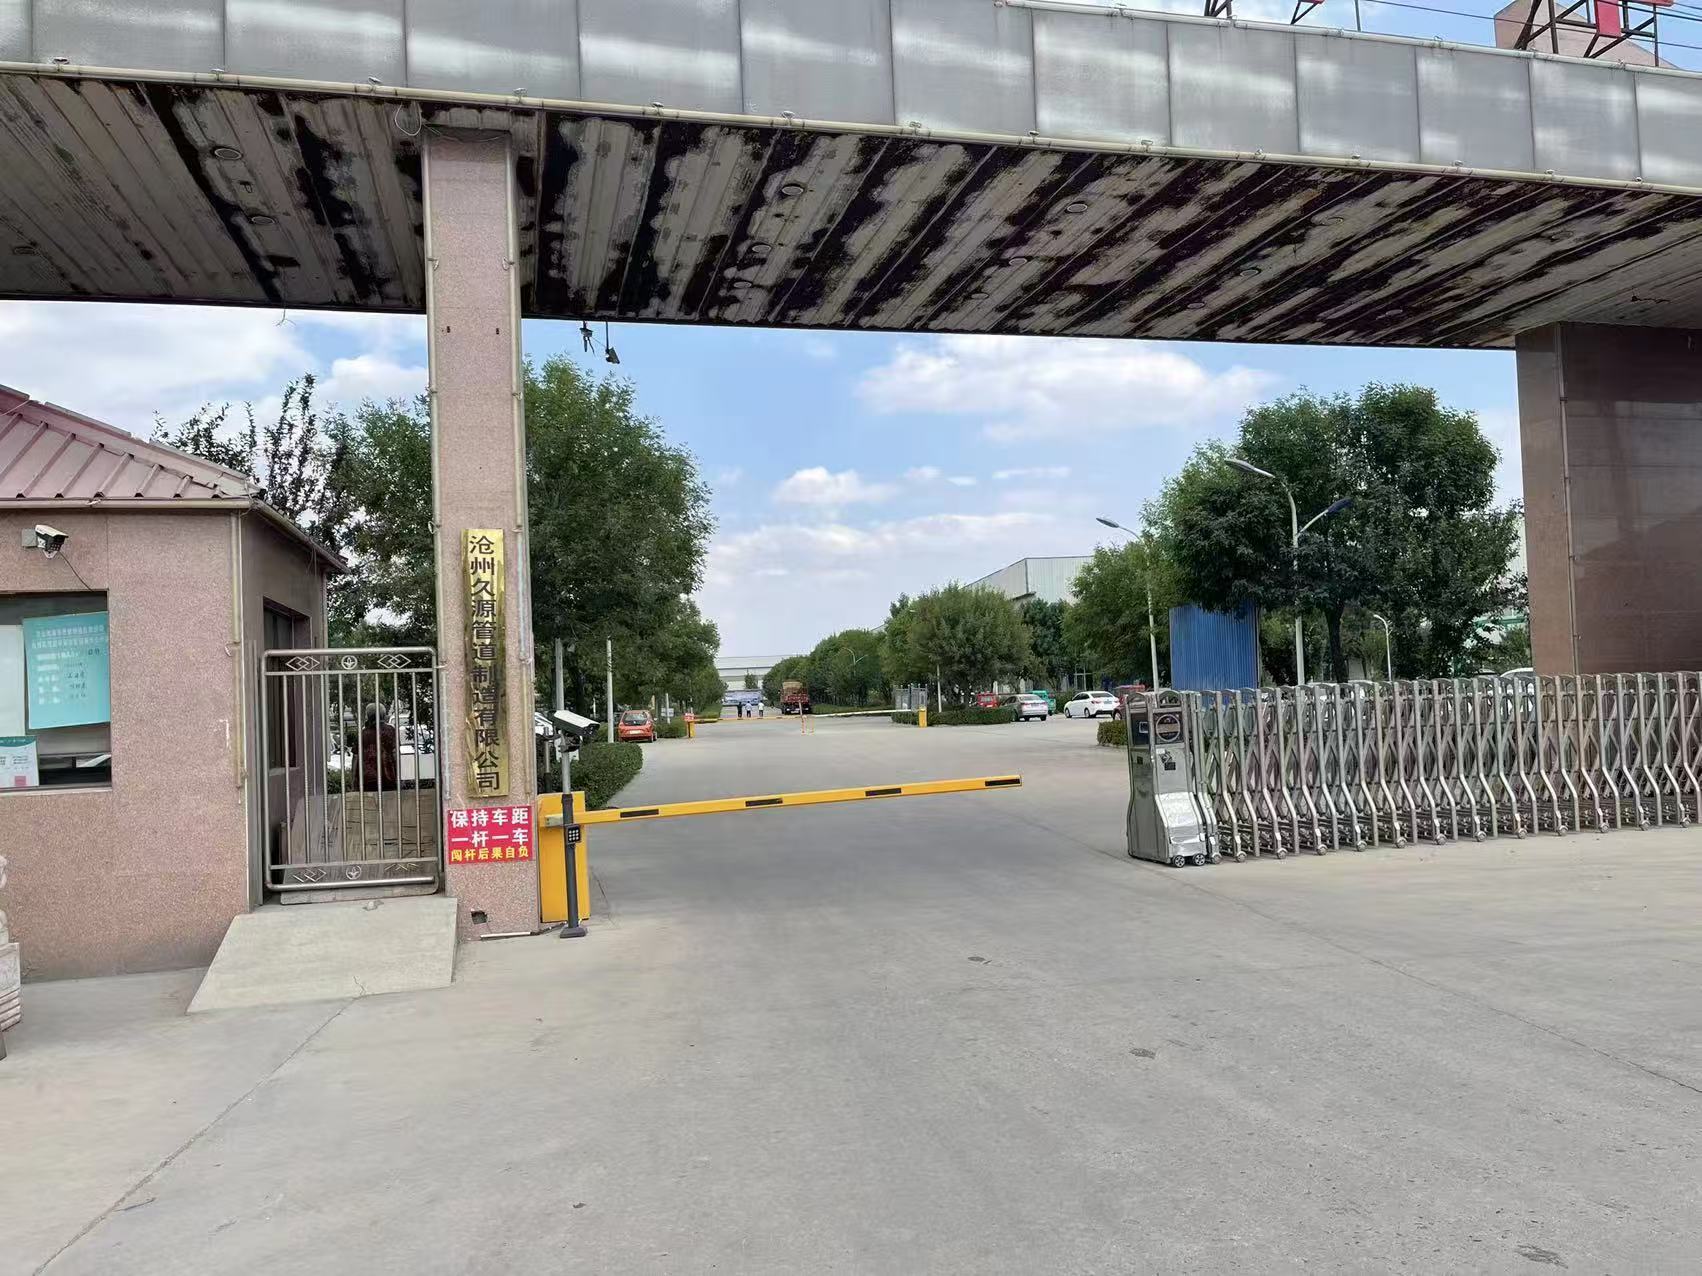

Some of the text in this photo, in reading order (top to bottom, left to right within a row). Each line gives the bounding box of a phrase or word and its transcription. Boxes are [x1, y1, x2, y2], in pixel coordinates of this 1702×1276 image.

[469, 535, 500, 790] 沧州久源管道制造有限公司
[450, 808, 529, 828] 保持车距
[451, 828, 529, 846] 一杆一车
[450, 846, 529, 862] 闯杆后果自负
